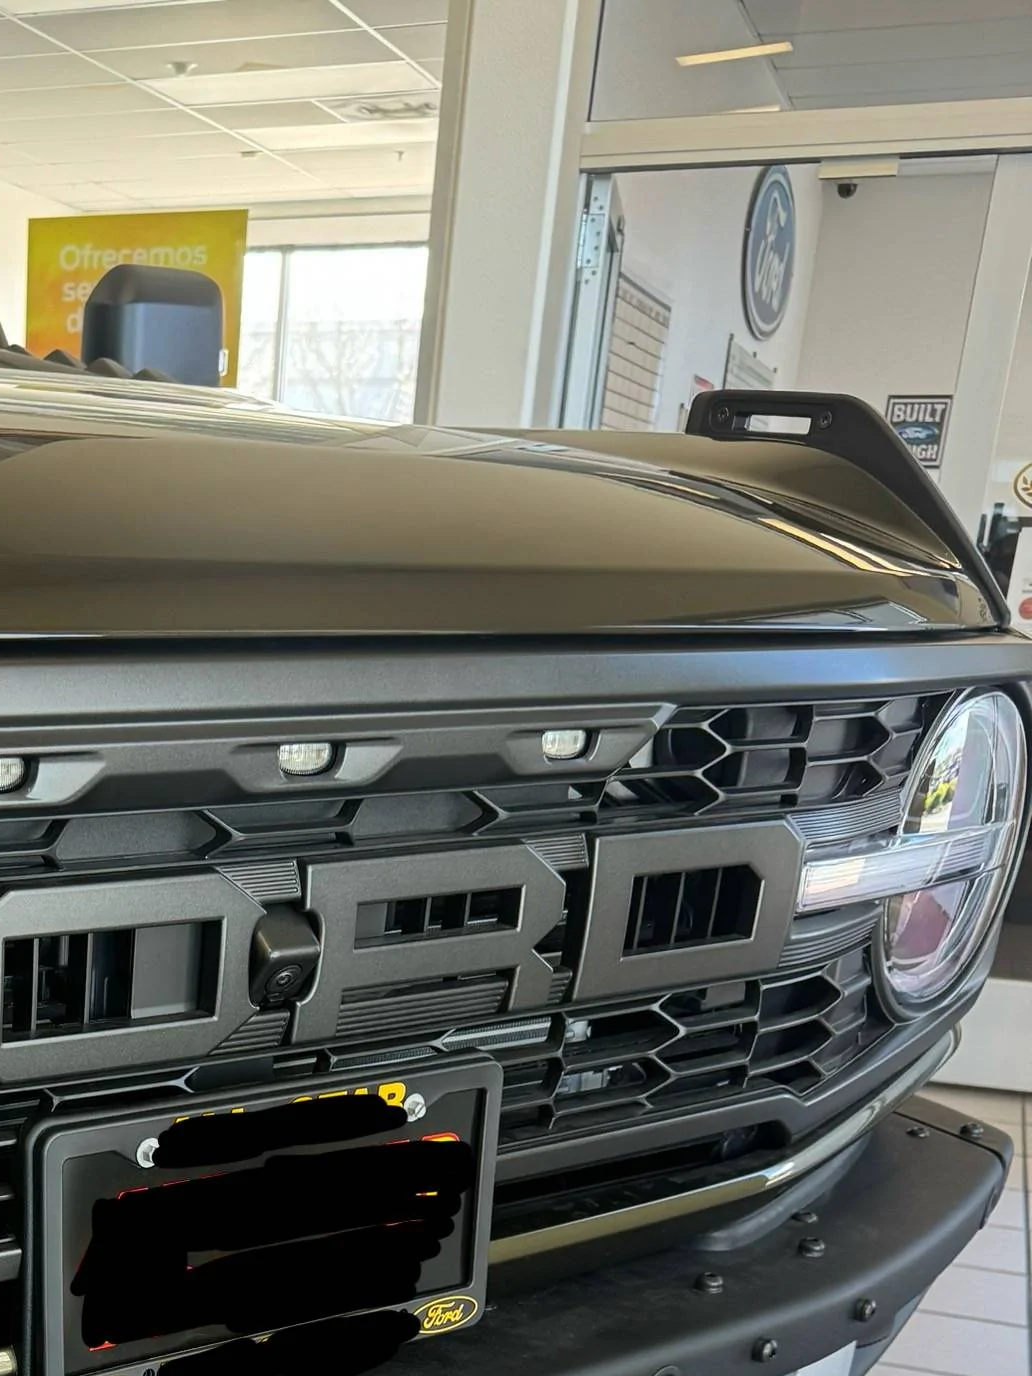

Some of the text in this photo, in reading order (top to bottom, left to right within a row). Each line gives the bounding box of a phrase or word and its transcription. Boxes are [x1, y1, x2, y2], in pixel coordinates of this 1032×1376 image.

[59, 243, 209, 272] Ofrecemos
[891, 403, 946, 422] BUILT
[422, 1301, 465, 1329] Ford
